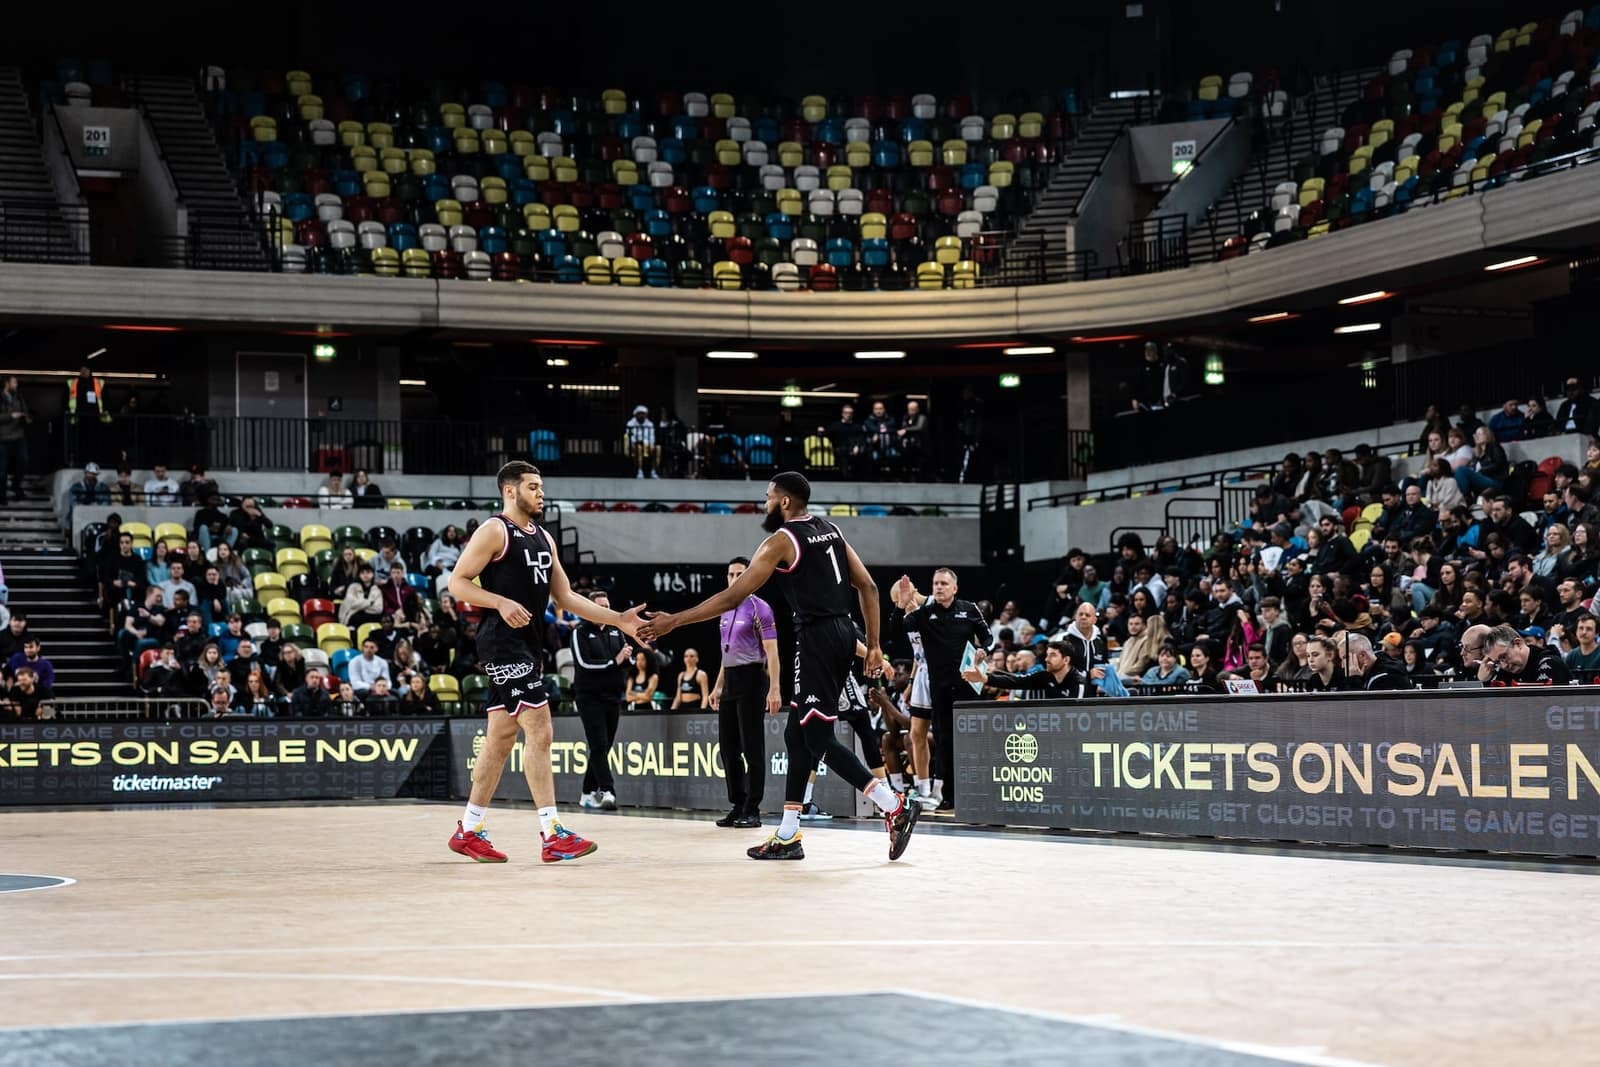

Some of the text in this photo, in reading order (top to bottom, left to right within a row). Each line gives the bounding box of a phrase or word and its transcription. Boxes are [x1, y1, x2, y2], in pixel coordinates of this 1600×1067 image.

[86, 130, 107, 141] 201
[1175, 144, 1194, 156] 202
[825, 545, 842, 585] 1
[1, 726, 35, 740] HE
[42, 725, 114, 739] GAME
[123, 725, 174, 738] GET
[179, 724, 279, 738] CLOSER
[285, 724, 320, 737] TO
[324, 723, 374, 737] THE
[379, 722, 446, 736] GAME
[957, 710, 1199, 733] GET CLOSER TO THE GAME
[111, 740, 180, 766] ON
[189, 739, 307, 765] SALE
[316, 738, 419, 763] NOW
[511, 742, 588, 775] TIETS
[606, 742, 624, 776] N
[627, 742, 690, 777] SALE
[693, 742, 748, 778] NO
[992, 766, 1053, 784] LONDON
[1082, 742, 1280, 793] TICKETS
[1292, 742, 1373, 795] ON
[1387, 742, 1551, 800] SALE
[112, 773, 219, 792] ticketmaster
[1001, 786, 1044, 803] LIONS
[1207, 802, 1251, 823] GET
[1257, 803, 1353, 827] CLOSER
[1359, 807, 1396, 830] TO
[1402, 807, 1457, 832] THE
[1463, 808, 1545, 835] GAME
